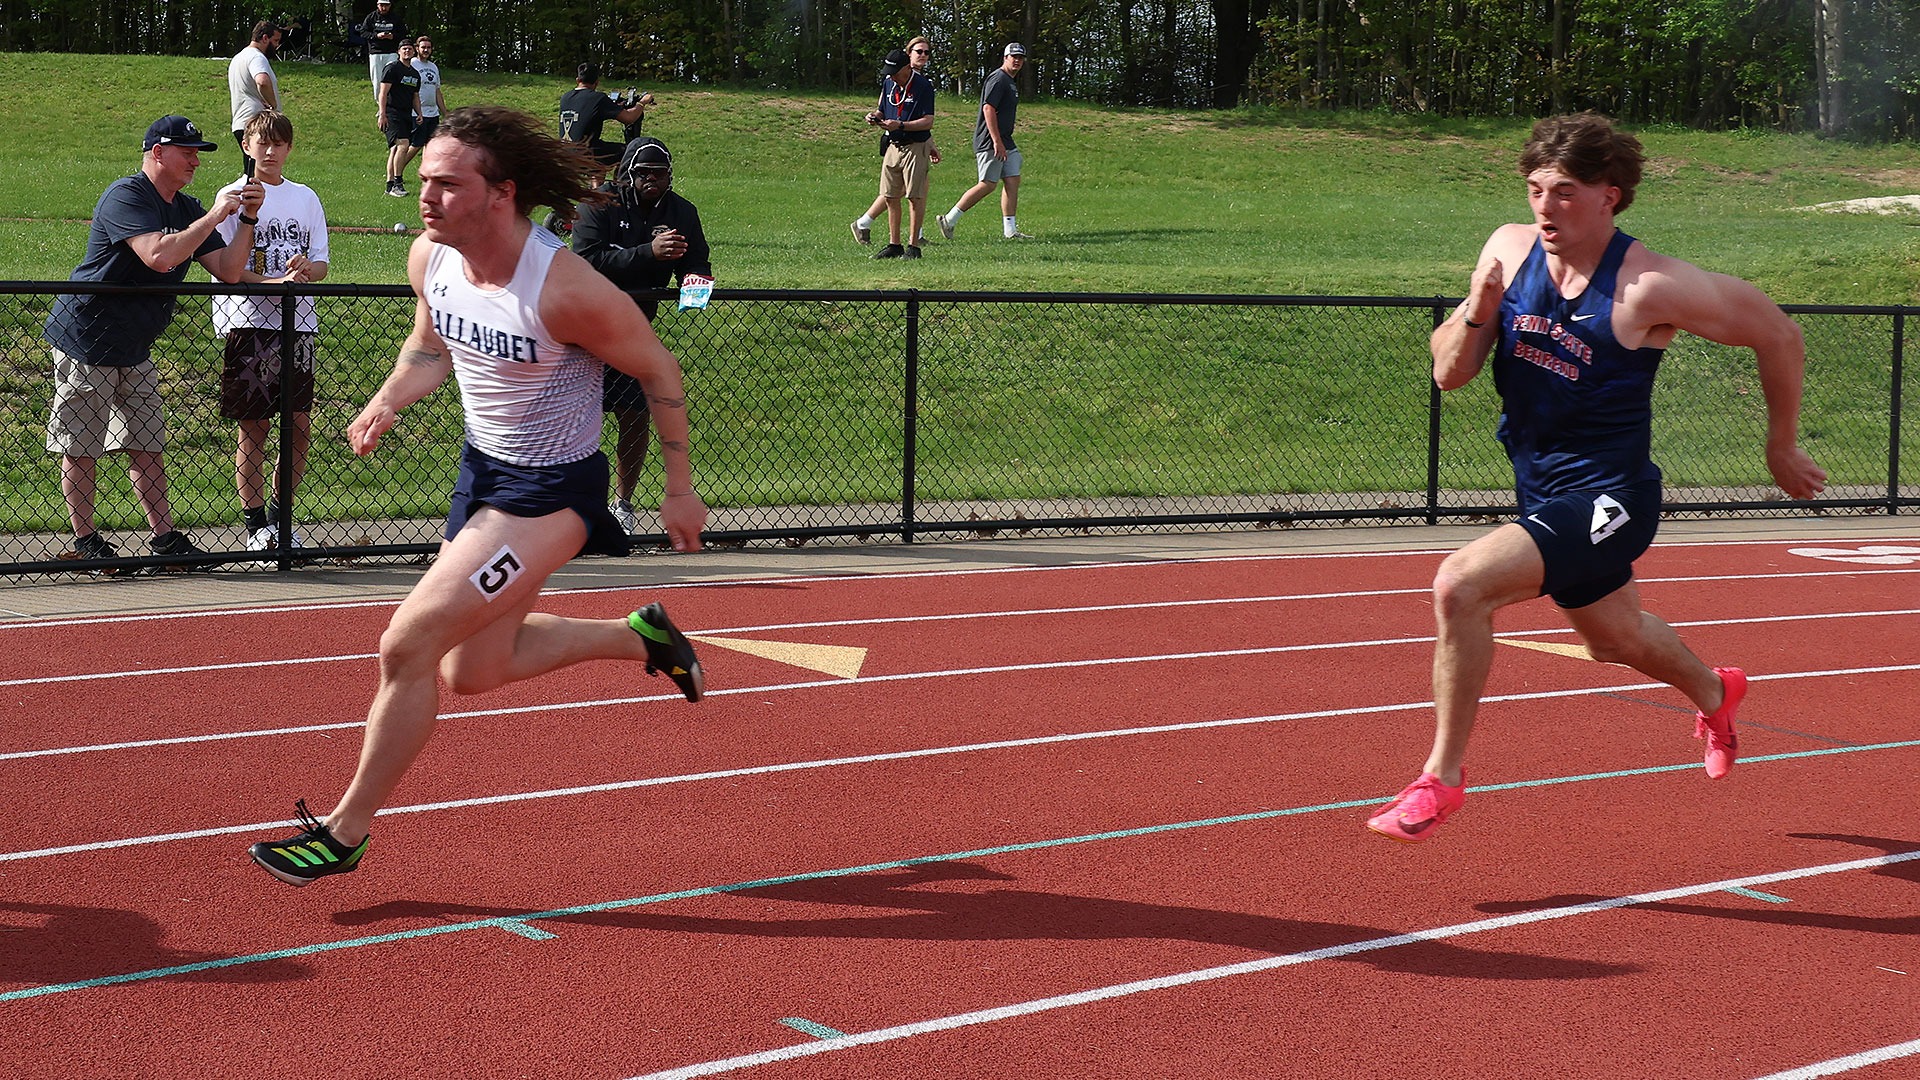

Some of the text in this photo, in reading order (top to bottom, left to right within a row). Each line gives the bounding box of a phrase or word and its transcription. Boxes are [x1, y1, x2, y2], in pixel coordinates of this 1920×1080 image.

[429, 306, 539, 364] ALLAUDET
[1512, 314, 1593, 366] PENN STATE
[1513, 340, 1580, 382] BEHREND
[479, 552, 520, 594] 5
